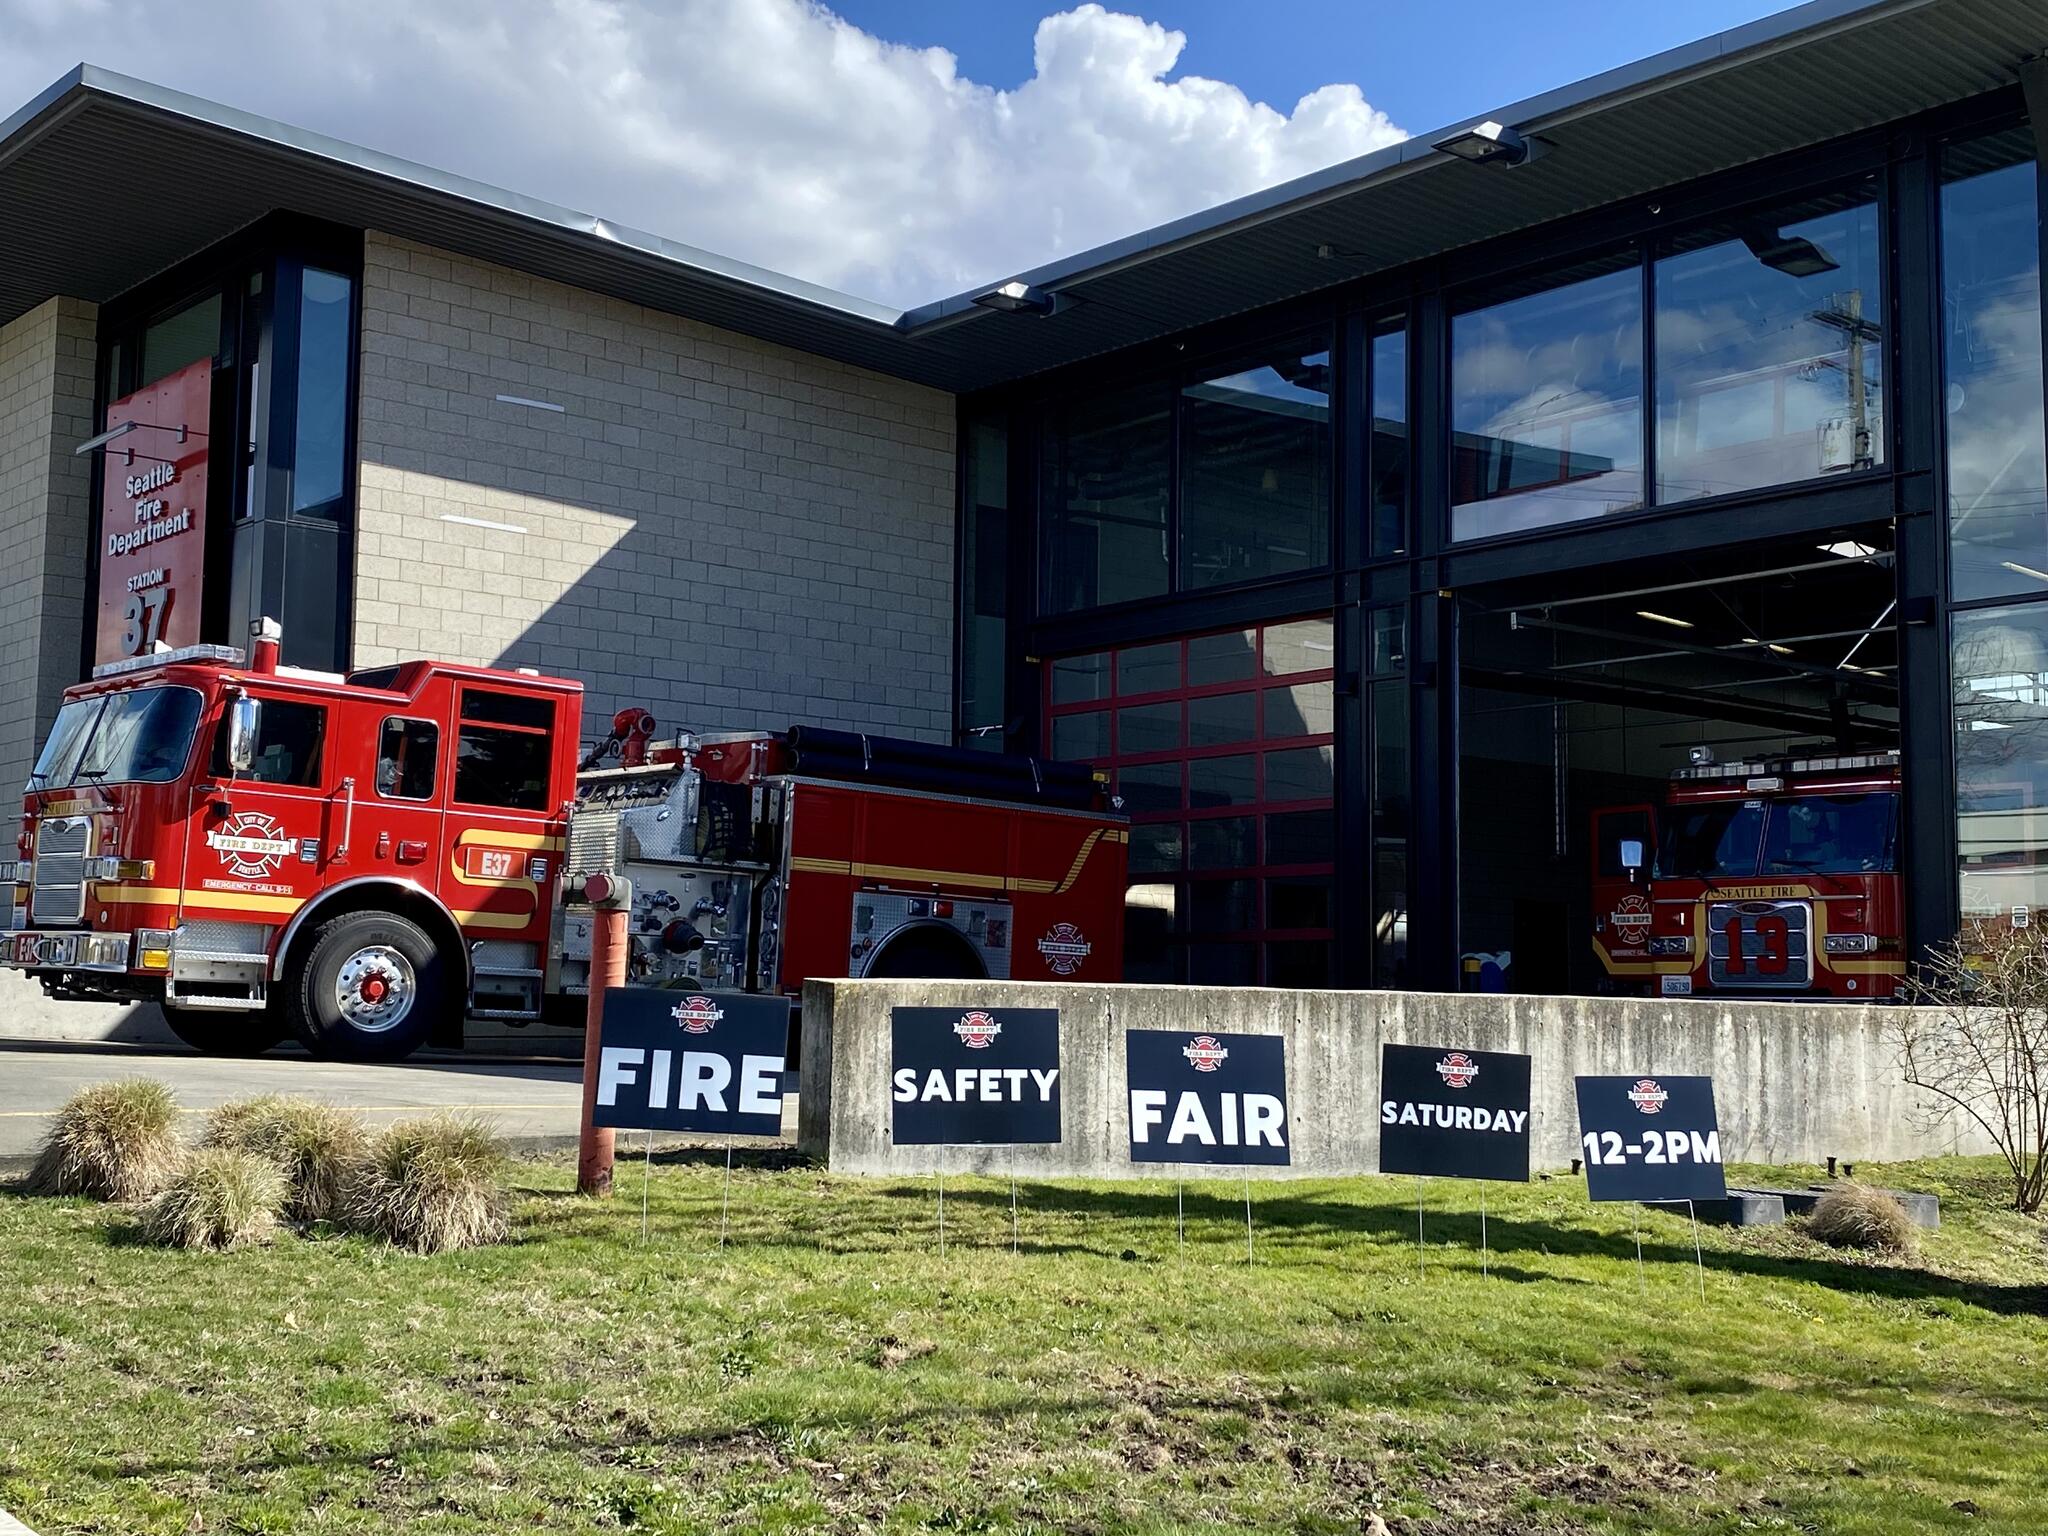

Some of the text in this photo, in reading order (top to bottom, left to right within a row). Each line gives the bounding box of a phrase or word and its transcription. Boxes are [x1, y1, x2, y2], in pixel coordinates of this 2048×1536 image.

[126, 462, 175, 499] Seattle
[134, 497, 163, 524] Fire
[107, 507, 190, 556] Department
[127, 567, 164, 592] STATION
[120, 586, 168, 656] 37
[219, 838, 247, 850] FIRE
[481, 851, 512, 877] E37
[1720, 886, 1797, 899] SEATTLE FIRE
[1724, 915, 1788, 975] 13
[596, 1046, 785, 1115] FIRE
[893, 1067, 1060, 1103] SAFETY
[1130, 1089, 1286, 1147] FAIR
[1381, 1100, 1528, 1133] SATURDAY
[1582, 1130, 1722, 1165] 12-2PM
